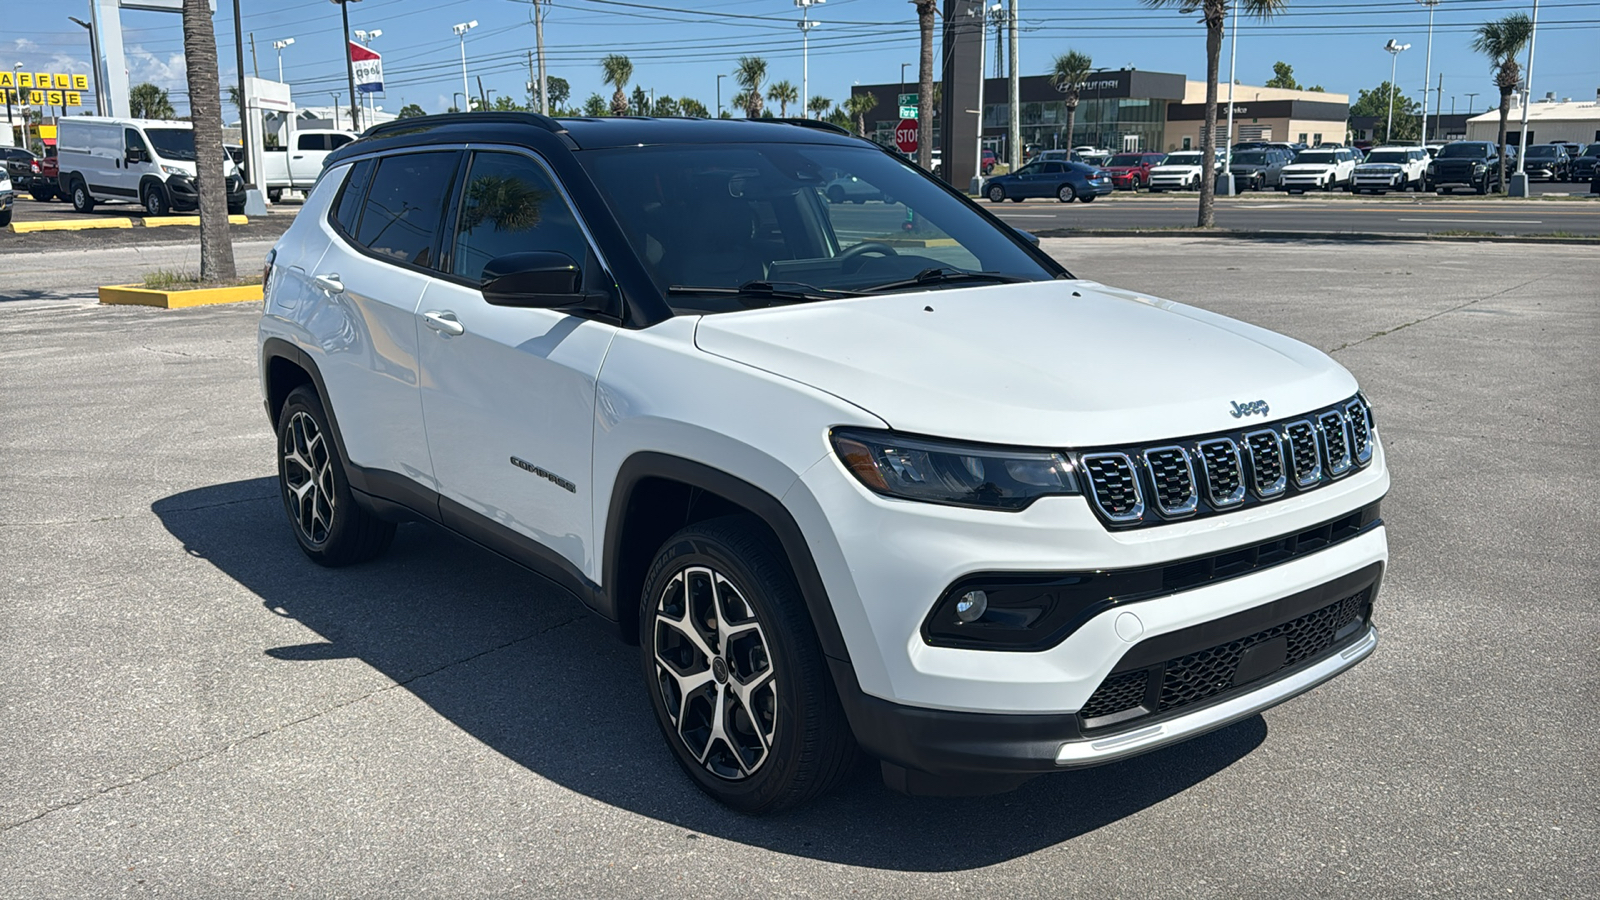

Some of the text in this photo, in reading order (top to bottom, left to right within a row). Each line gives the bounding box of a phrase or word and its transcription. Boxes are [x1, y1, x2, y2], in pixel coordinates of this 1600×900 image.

[1, 74, 86, 88] AFFLE
[0, 91, 79, 105] USE
[1223, 106, 1248, 115] Svice
[1229, 400, 1270, 419] Jeep
[510, 456, 577, 494] COMPASS
[640, 546, 676, 613] IRONMAN
